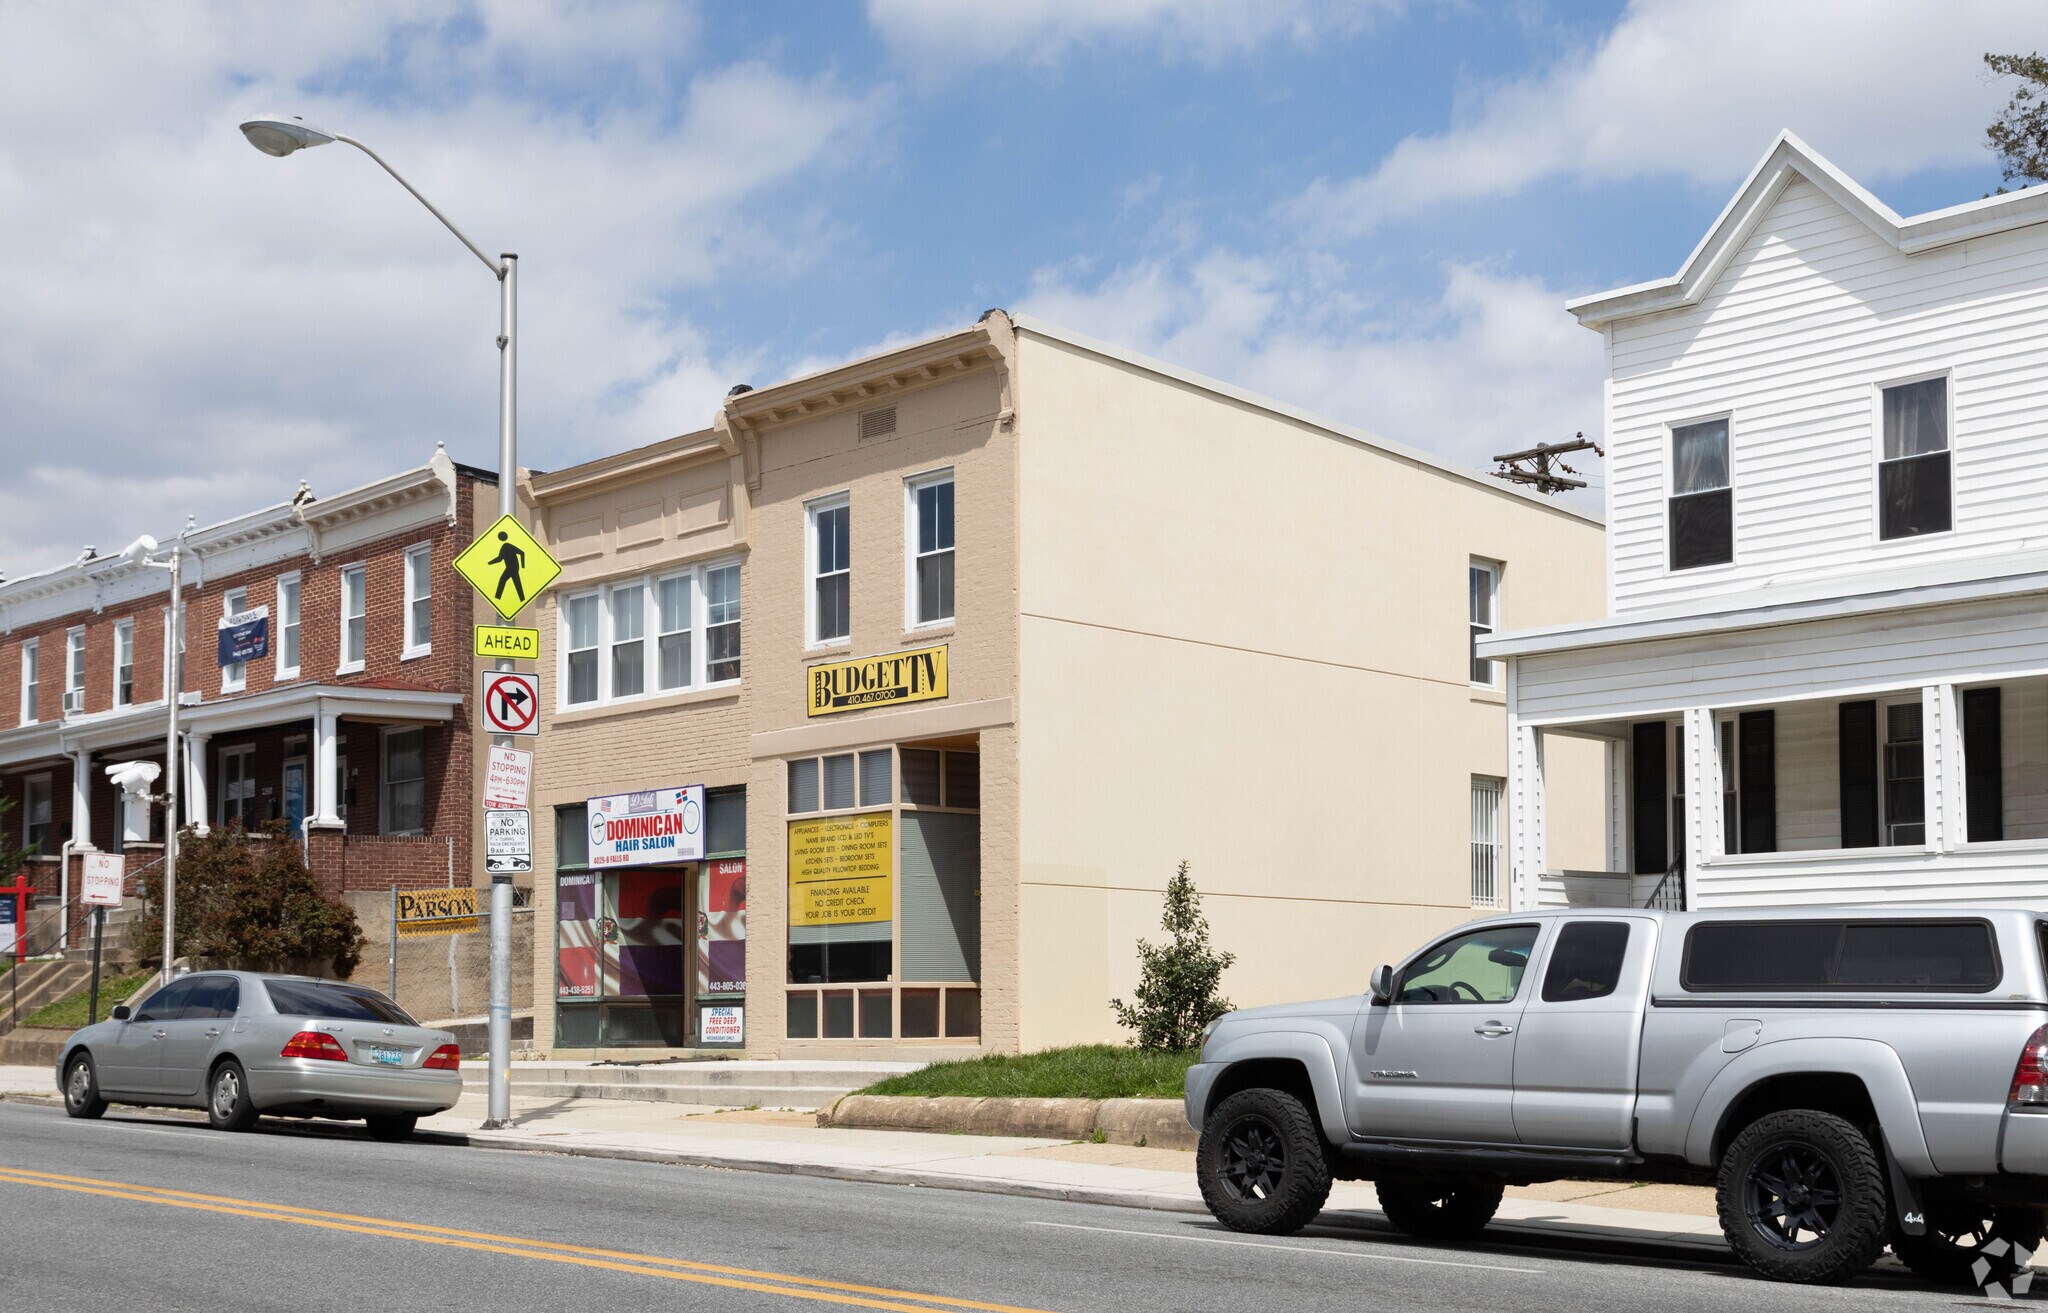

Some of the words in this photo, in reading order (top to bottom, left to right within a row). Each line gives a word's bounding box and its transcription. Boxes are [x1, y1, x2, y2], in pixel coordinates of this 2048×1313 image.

[484, 634, 532, 651] AHEAD
[814, 658, 905, 708] BUDGET
[905, 651, 942, 695] TV
[847, 689, 896, 704] 410.467.0700
[503, 752, 516, 761] NO
[491, 761, 527, 775] STOPPING
[486, 800, 497, 808] TOW
[500, 818, 514, 827] NO
[606, 813, 683, 841] DOMINICAN
[794, 826, 819, 835] APPLIANCES
[825, 823, 854, 832] ELECTRONICS
[860, 820, 888, 829] COMPUTERS
[489, 828, 526, 836] PARKING
[615, 840, 640, 852] HAIR
[642, 836, 675, 850] SALON
[820, 835, 836, 843] BRAND
[860, 842, 875, 850] ROOM
[610, 854, 622, 863] FALLS
[805, 857, 822, 865] KITCHEN
[839, 854, 863, 862] BEDROOM
[99, 860, 110, 869] NO
[719, 862, 743, 874] SALON
[813, 867, 831, 875] QUALITY
[832, 865, 857, 873] PILLOWTOP
[87, 875, 120, 887] STOPPING
[560, 873, 595, 887] DOMINICAN
[810, 888, 840, 896] FINANCING
[842, 886, 869, 894] AVAILABLE
[846, 897, 865, 905] CHECK
[399, 895, 475, 920] PARSON
[805, 911, 819, 919] YOUR
[821, 910, 831, 918] JOB
[857, 908, 876, 916] CREDIT
[711, 1007, 734, 1016] SPECIAL
[709, 1016, 722, 1025] FREE
[723, 1016, 737, 1025] DEEP
[705, 1025, 741, 1035] CONDITIONER
[1370, 1069, 1419, 1079] TACOMA
